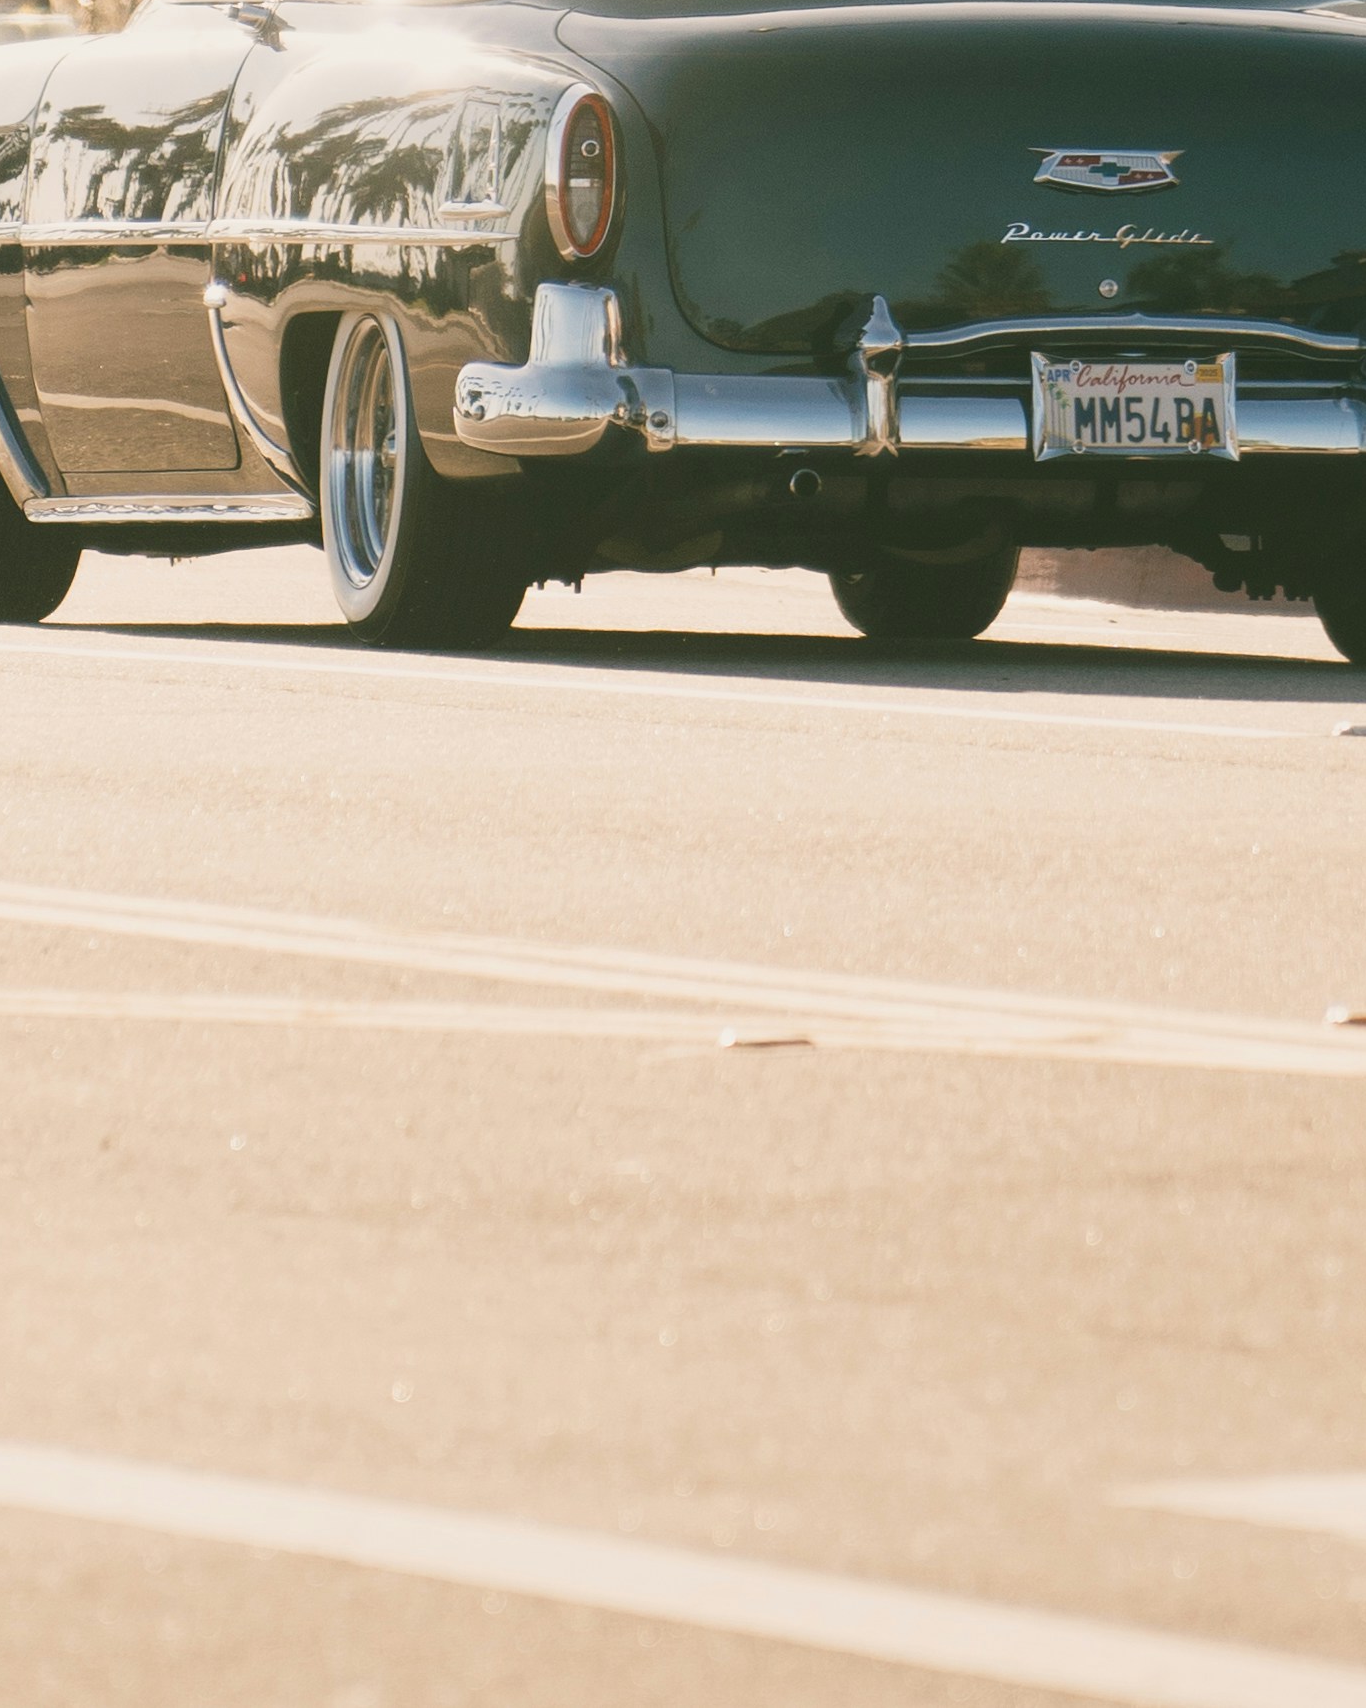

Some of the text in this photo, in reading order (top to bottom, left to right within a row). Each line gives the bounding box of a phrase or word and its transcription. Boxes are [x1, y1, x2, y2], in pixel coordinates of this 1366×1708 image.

[1047, 369, 1071, 383] APR
[1076, 365, 1194, 394] California
[1074, 396, 1221, 444] MM54BA
